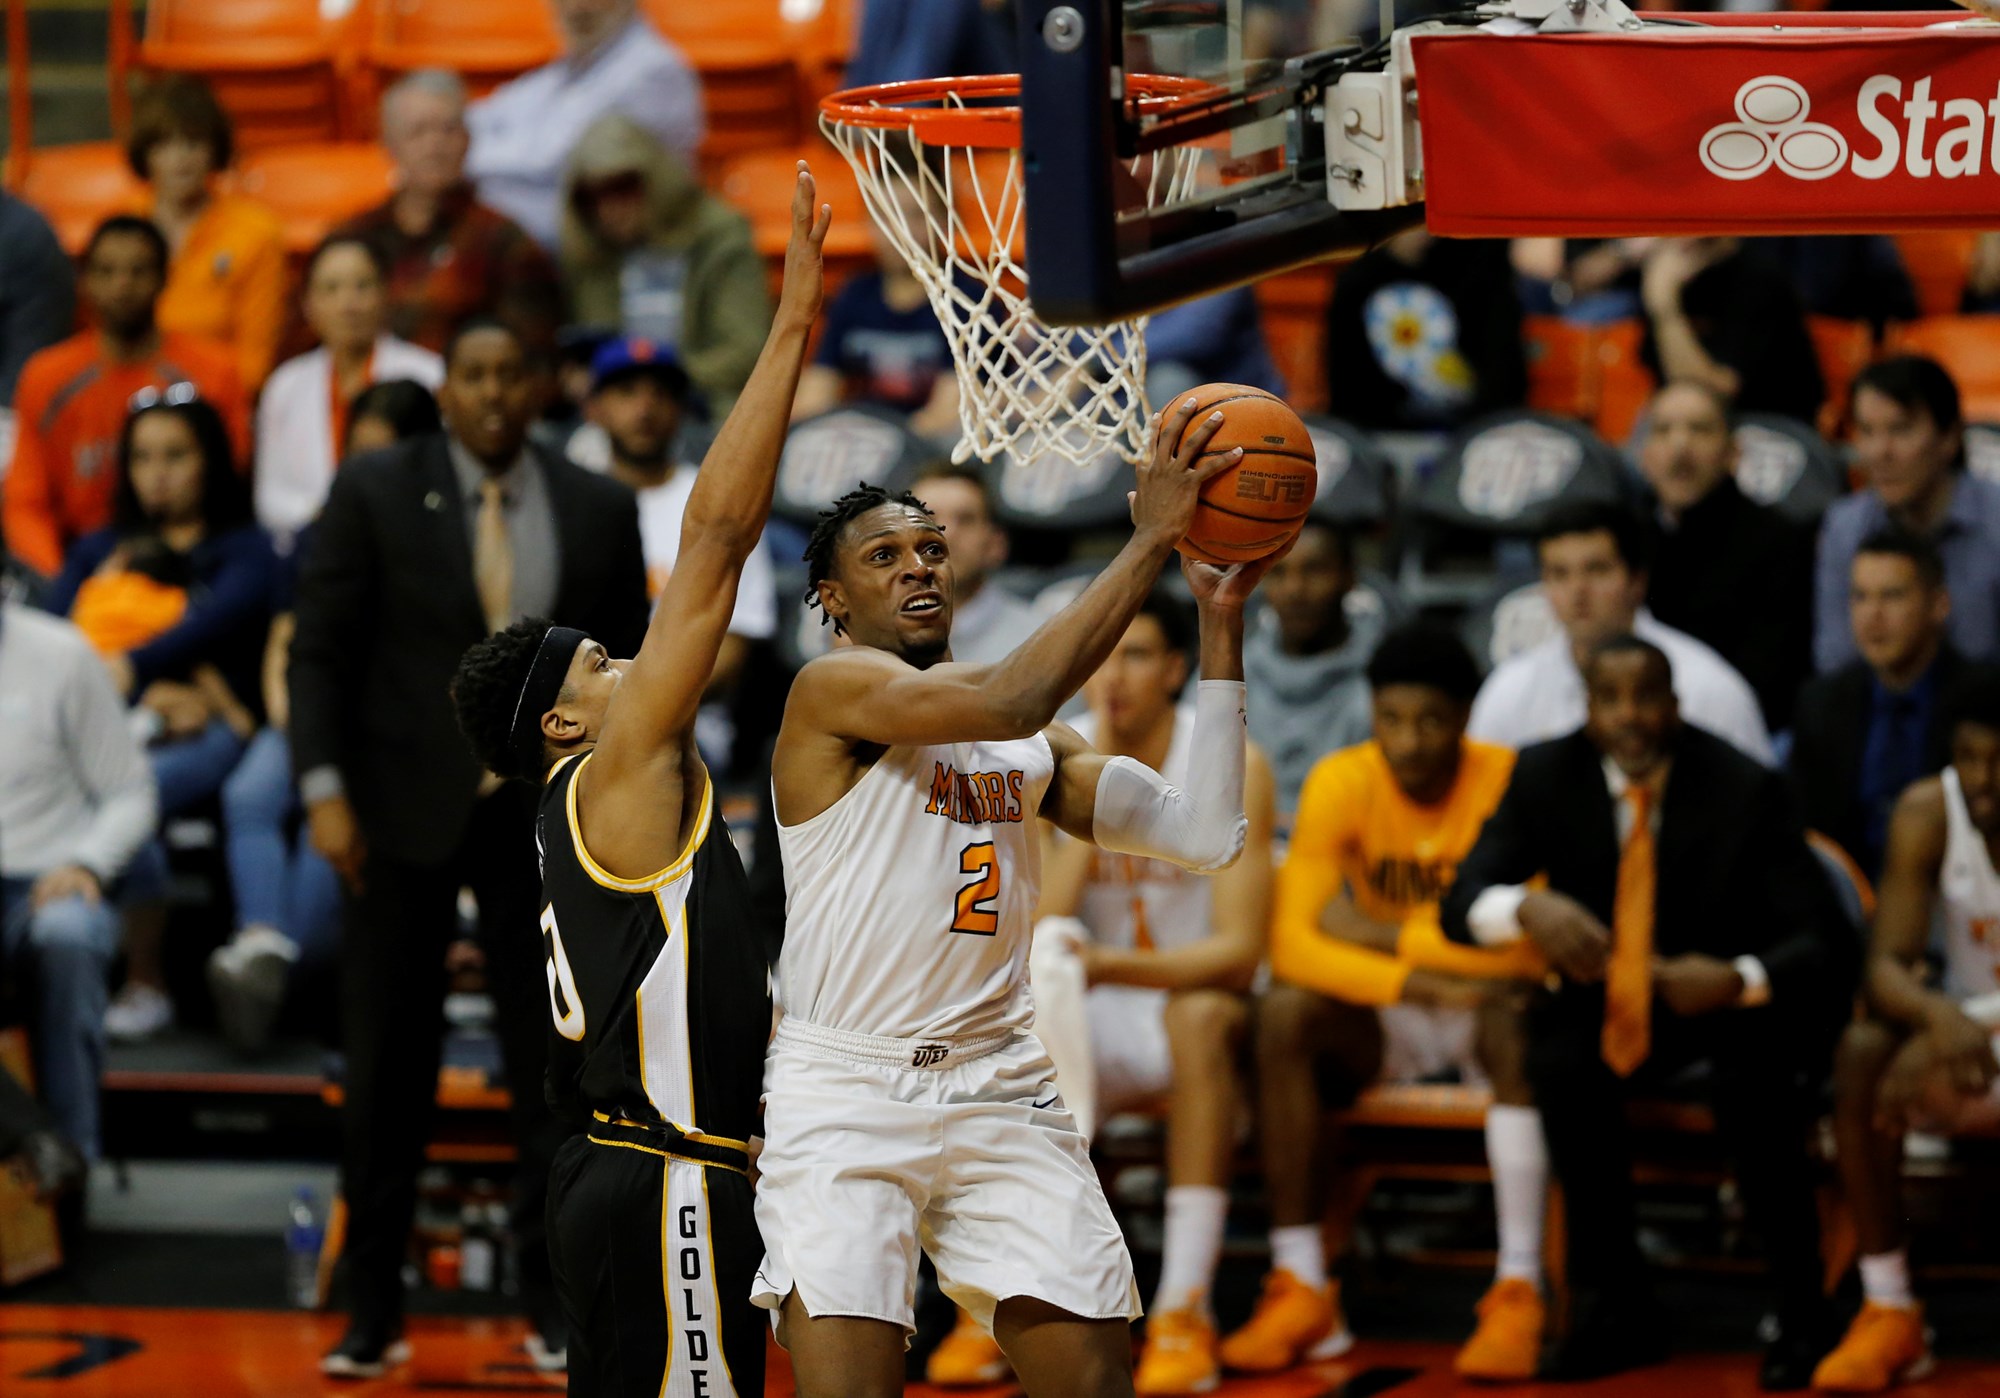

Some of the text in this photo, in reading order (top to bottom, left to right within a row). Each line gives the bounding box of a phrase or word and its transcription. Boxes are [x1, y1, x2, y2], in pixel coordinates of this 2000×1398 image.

[1236, 476, 1306, 503] ELITE
[949, 841, 1000, 936] 2
[912, 1044, 949, 1068] UTEP
[679, 1206, 710, 1398] GOLDE
